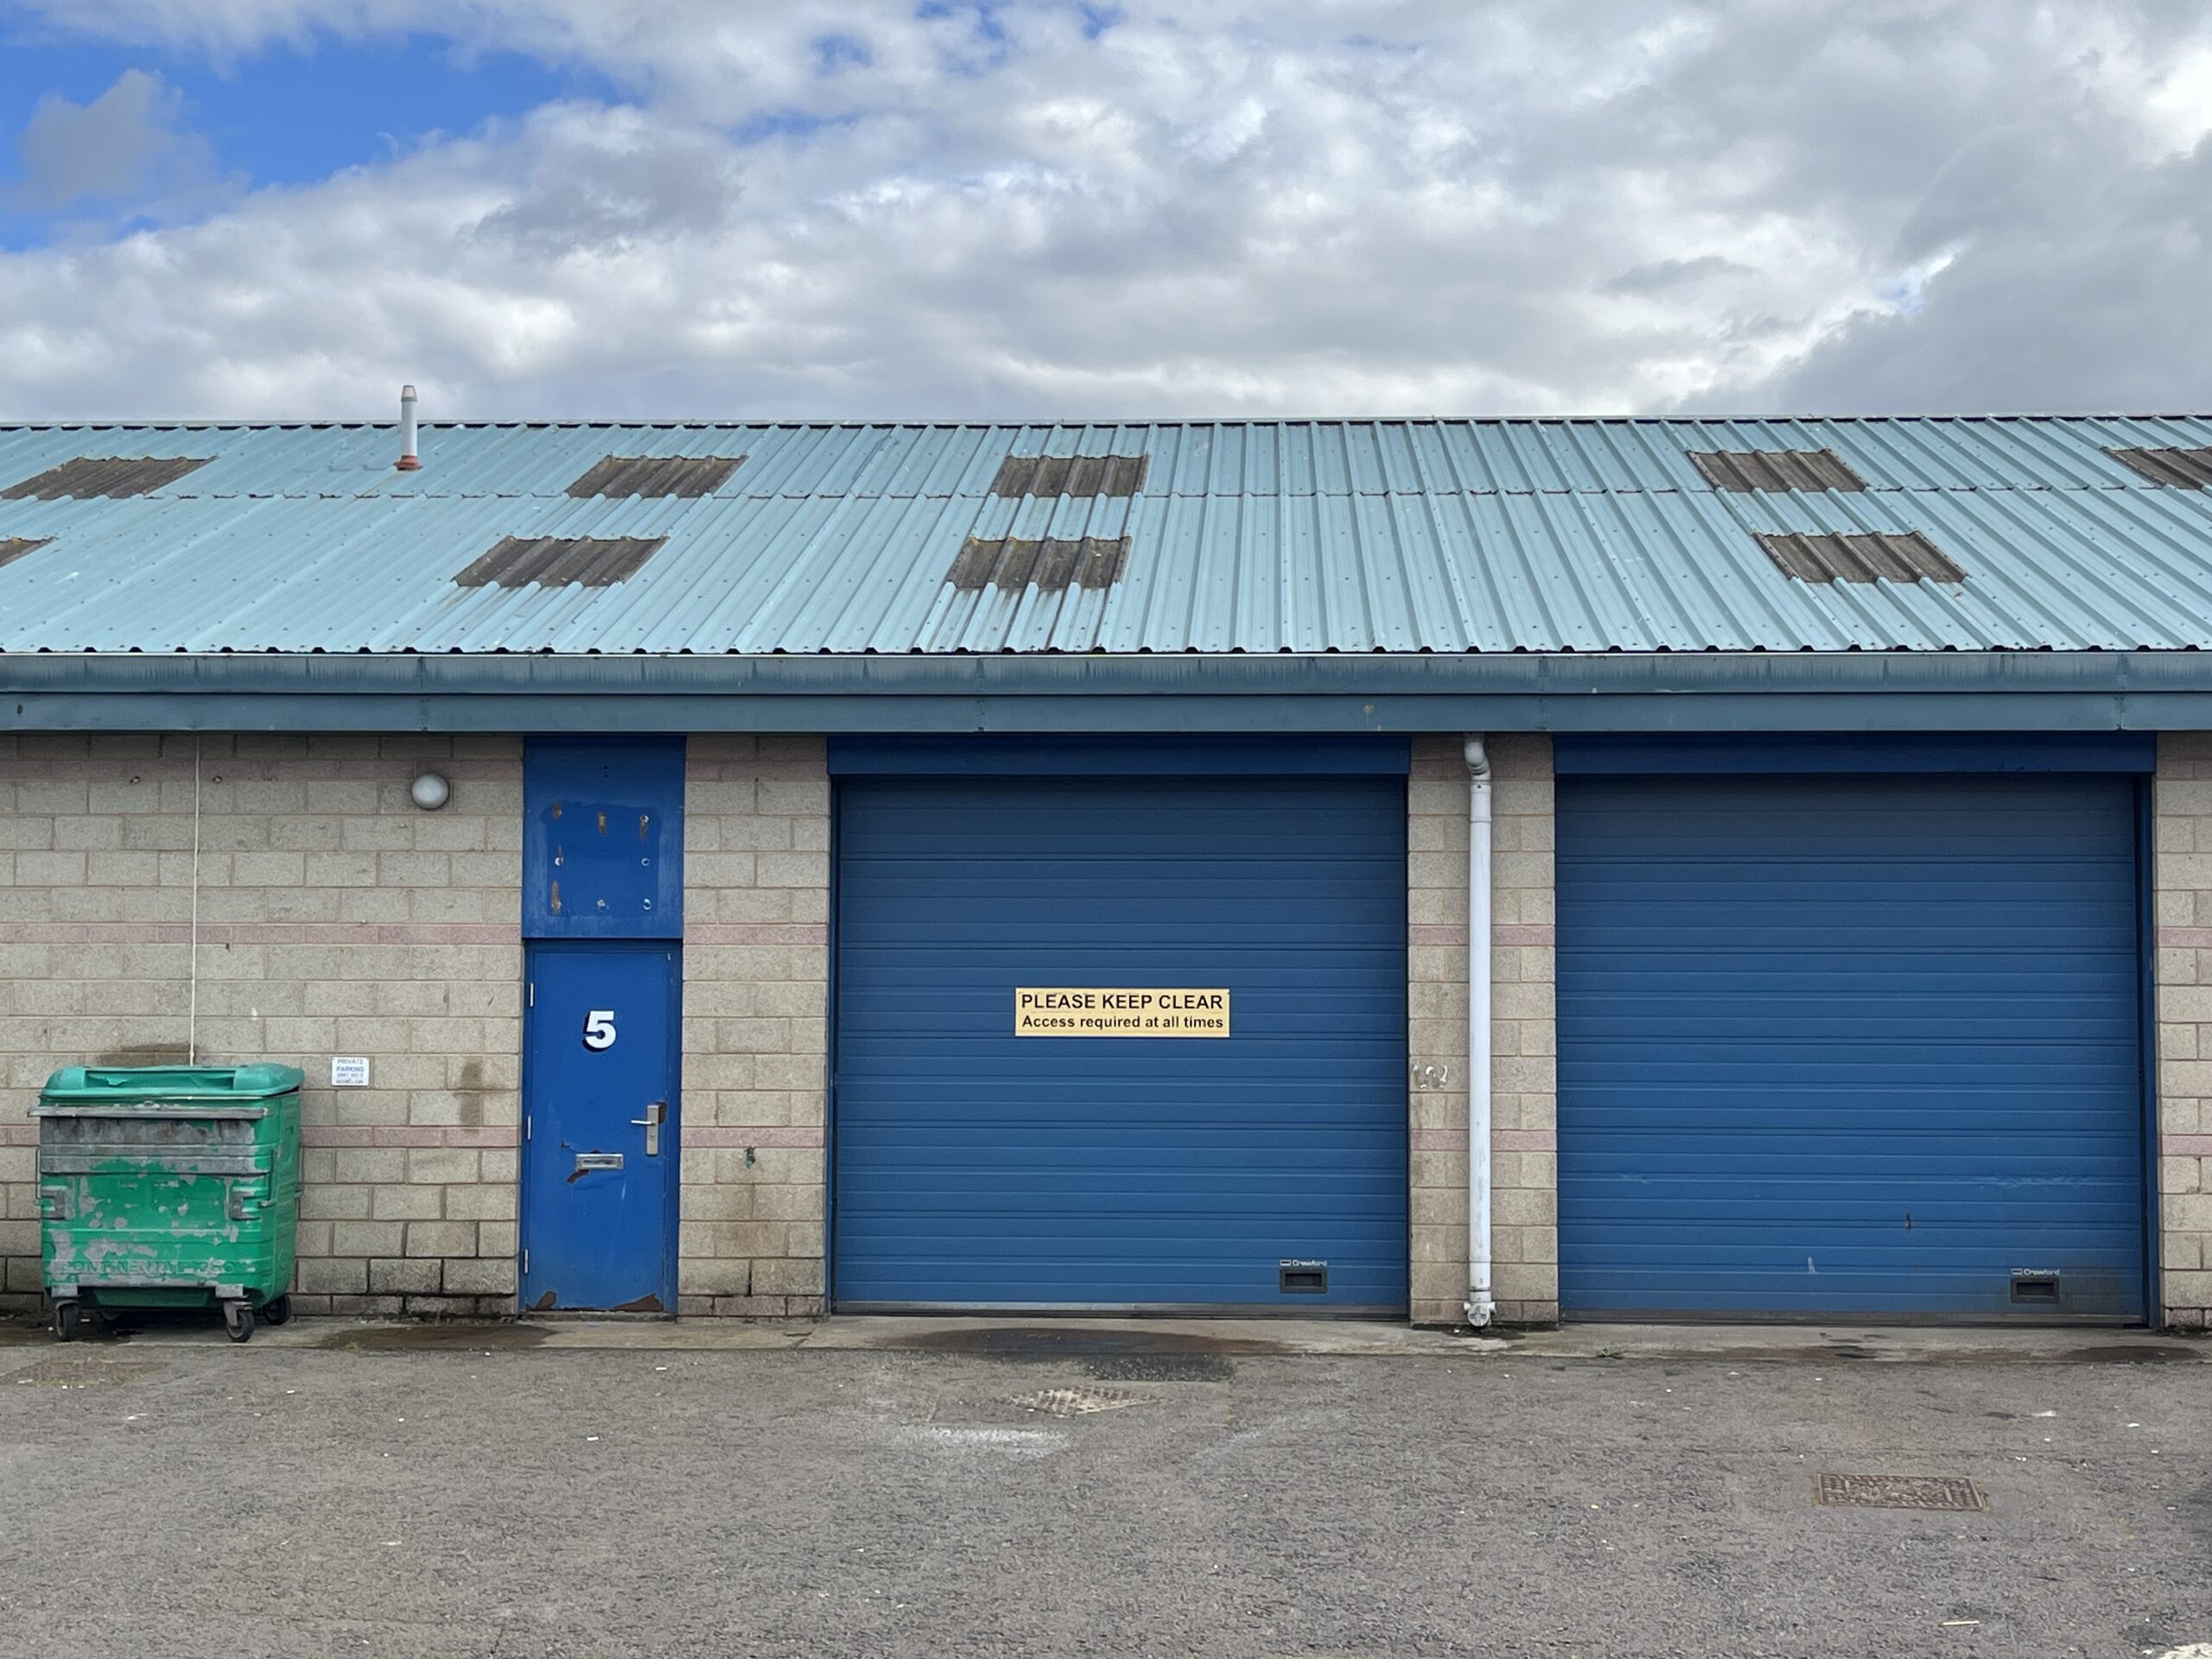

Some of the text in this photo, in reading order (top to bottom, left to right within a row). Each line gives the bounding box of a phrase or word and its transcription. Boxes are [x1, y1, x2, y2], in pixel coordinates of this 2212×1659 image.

[1021, 994, 1223, 1009] PLEASE KEEP CLEAR
[583, 1010, 616, 1050] 5
[1021, 1015, 1224, 1030] Access required at all times
[2024, 1268, 2061, 1276] Crawford
